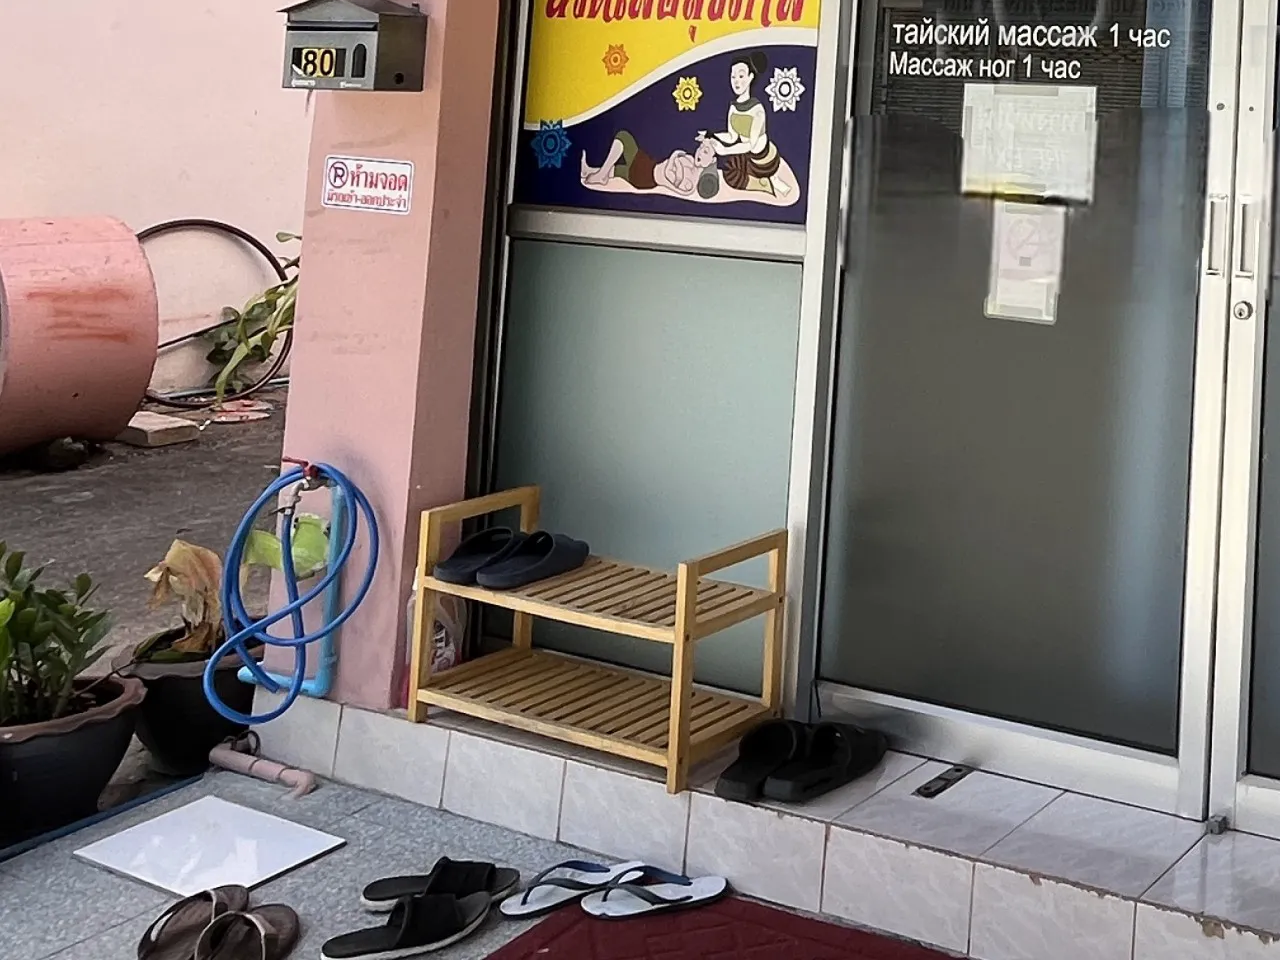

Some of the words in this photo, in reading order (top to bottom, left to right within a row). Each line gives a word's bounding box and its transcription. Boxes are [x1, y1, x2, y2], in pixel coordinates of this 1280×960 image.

[892, 17, 990, 47] тайский
[998, 23, 1097, 48] массаж
[1108, 23, 1119, 48] 1
[1129, 27, 1171, 49] час
[303, 49, 334, 76] 80
[889, 51, 973, 78] Массаж
[979, 57, 1016, 78] ног
[1022, 53, 1033, 78] 1
[1041, 59, 1081, 79] час
